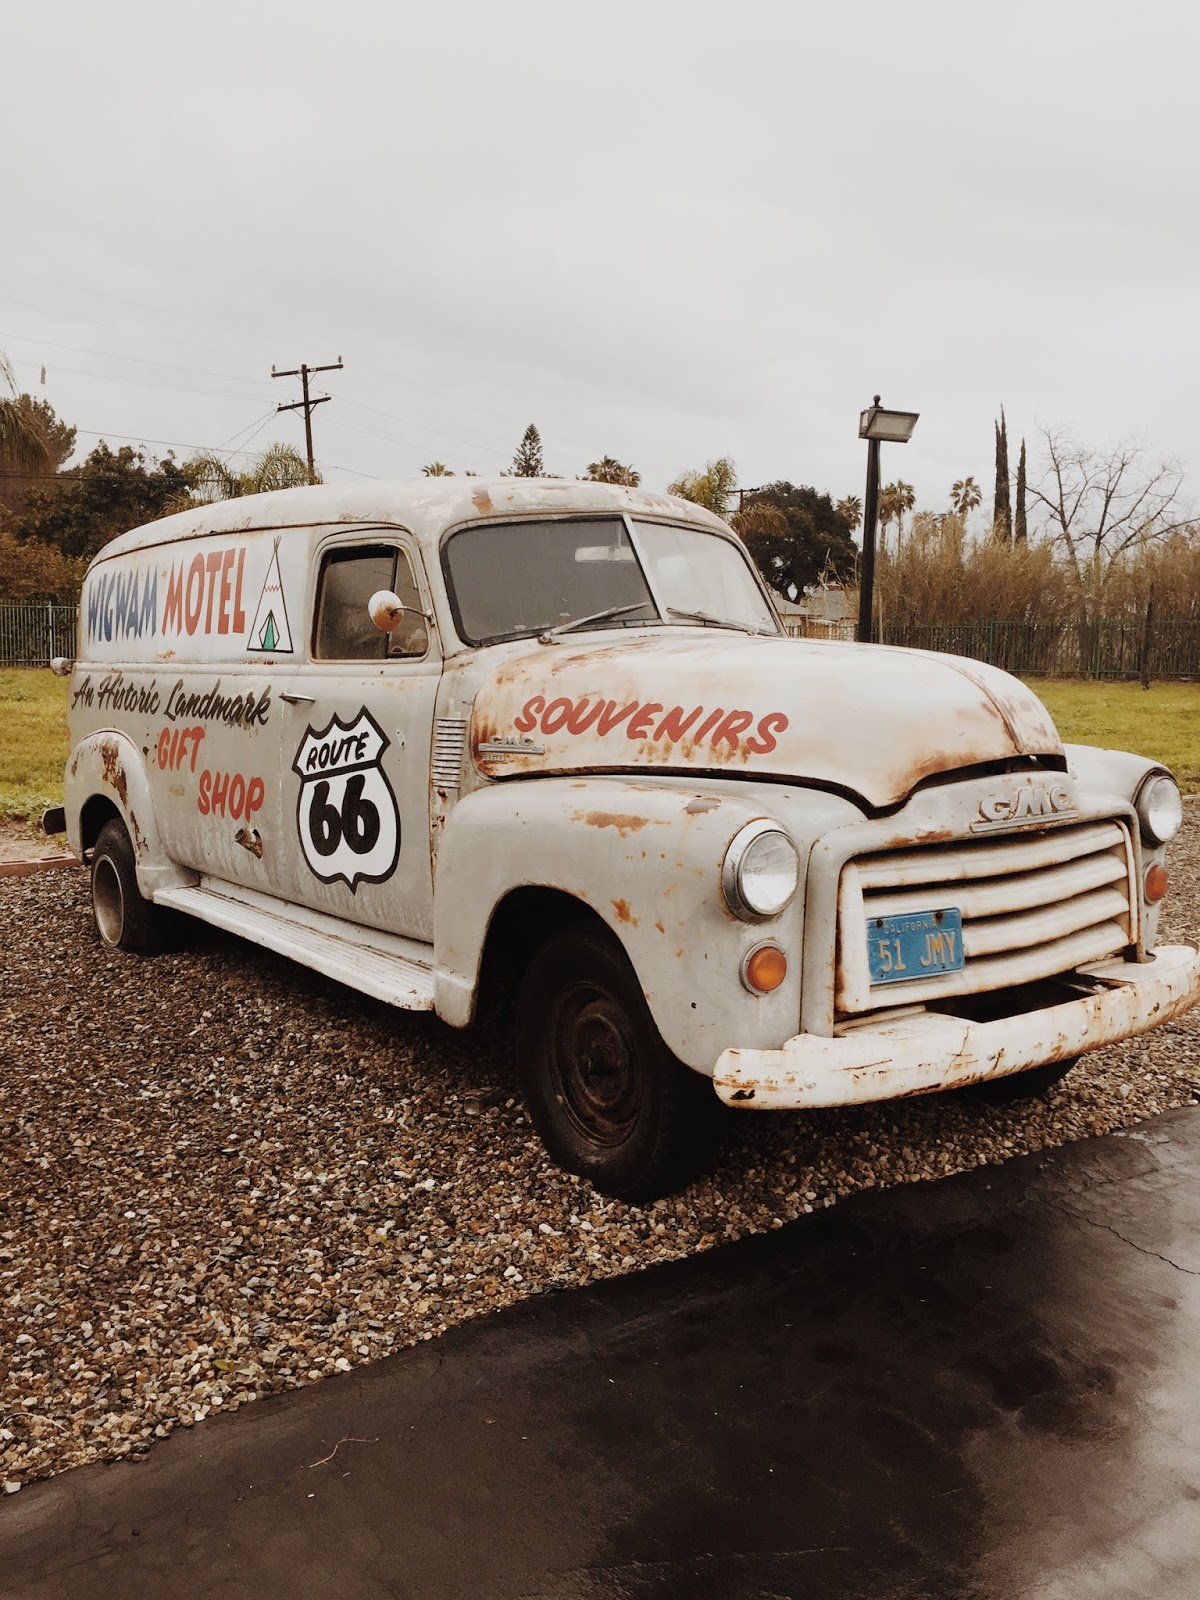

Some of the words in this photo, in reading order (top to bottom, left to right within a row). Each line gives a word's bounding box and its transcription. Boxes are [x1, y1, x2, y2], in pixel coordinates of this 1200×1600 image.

[88, 560, 158, 644] WIGWAM
[161, 547, 247, 637] MOTEL
[71, 674, 94, 710] An
[97, 672, 161, 715] Historic
[164, 678, 271, 725] Landmark
[489, 735, 535, 746] GMC
[514, 695, 789, 754] SOUVENIRS
[157, 726, 206, 773] GIFT
[306, 731, 370, 771] ROUTE
[197, 769, 265, 823] SHOP
[309, 774, 380, 857] 66
[979, 786, 1072, 822] GMC
[884, 919, 937, 934] CALIFORNIA
[879, 939, 906, 972] 51
[920, 931, 956, 967] JMY
